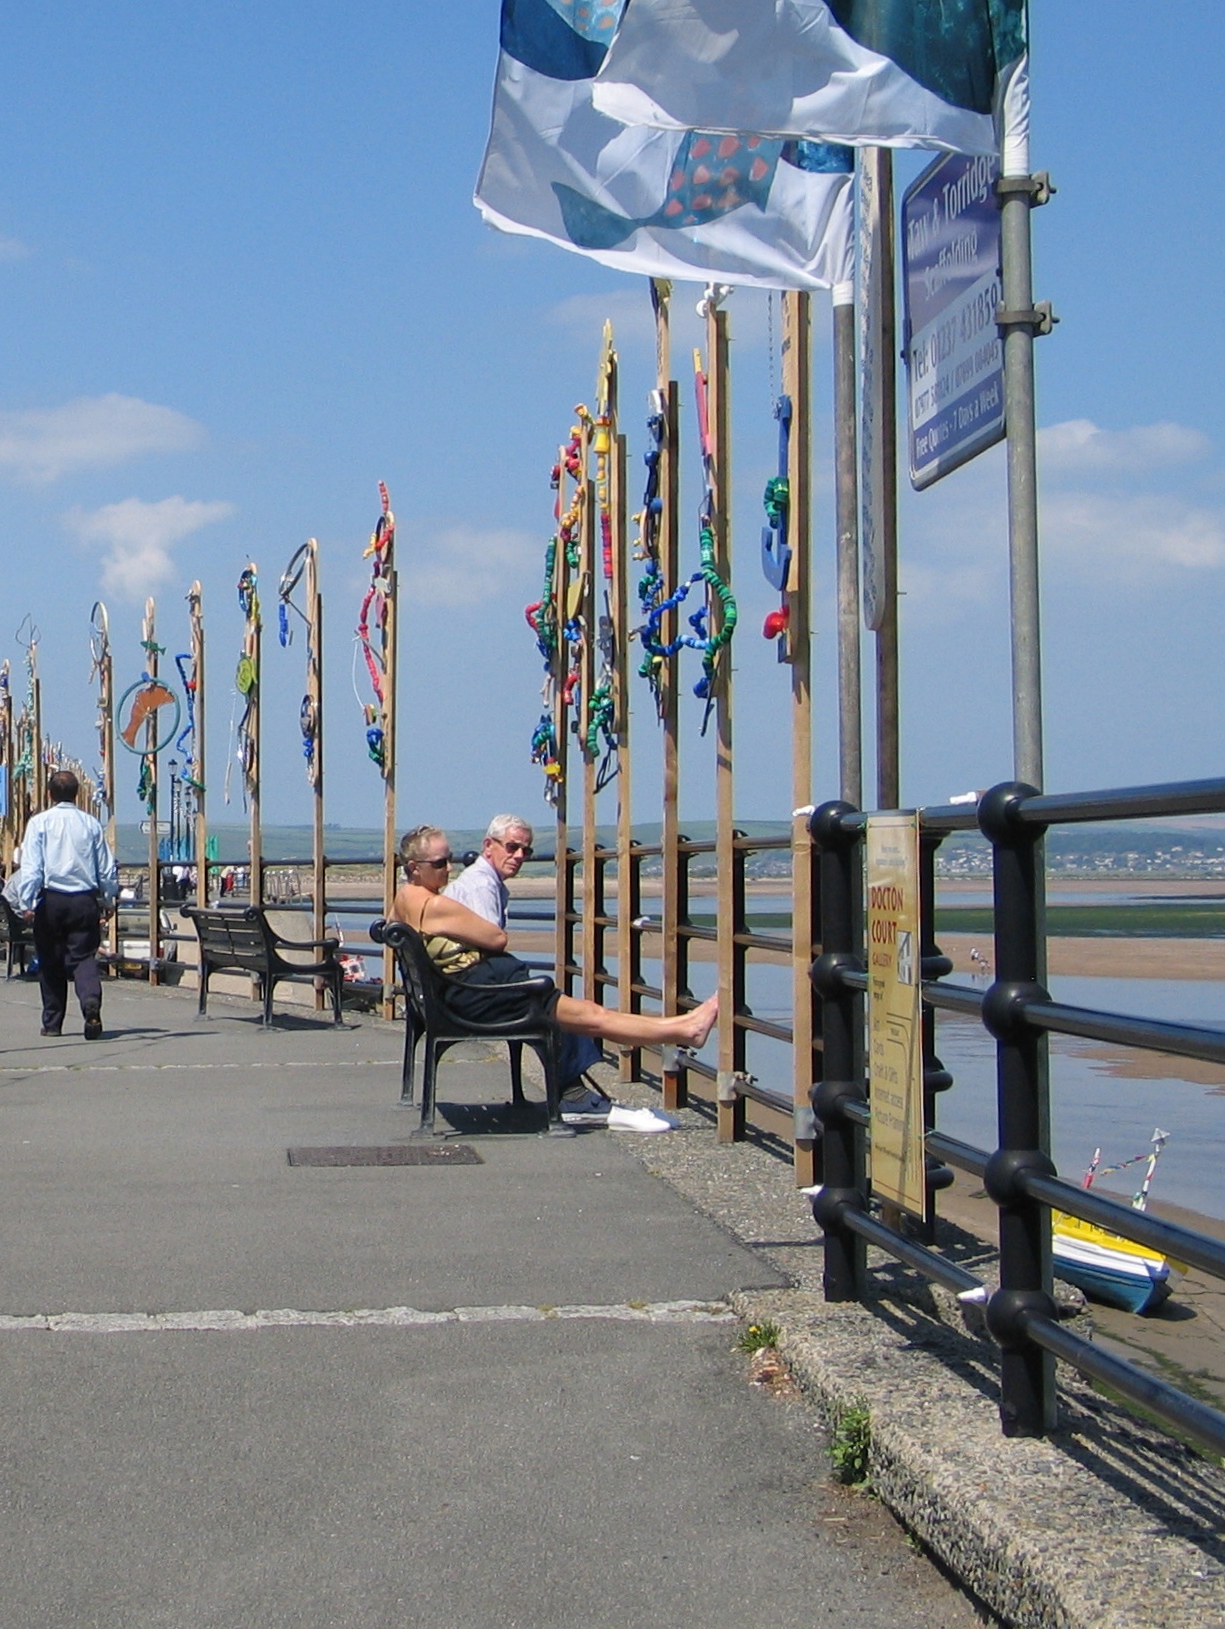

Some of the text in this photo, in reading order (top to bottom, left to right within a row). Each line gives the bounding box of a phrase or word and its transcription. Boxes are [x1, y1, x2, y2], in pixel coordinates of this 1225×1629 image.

[932, 197, 941, 238] &
[942, 155, 996, 223] Torridge
[924, 224, 978, 301] Scaffolding
[913, 344, 929, 383] Tel:
[916, 432, 928, 460] Free
[957, 402, 973, 430] Days
[980, 381, 999, 414] Week
[871, 886, 904, 912] DOCTON
[871, 921, 897, 946] COURT
